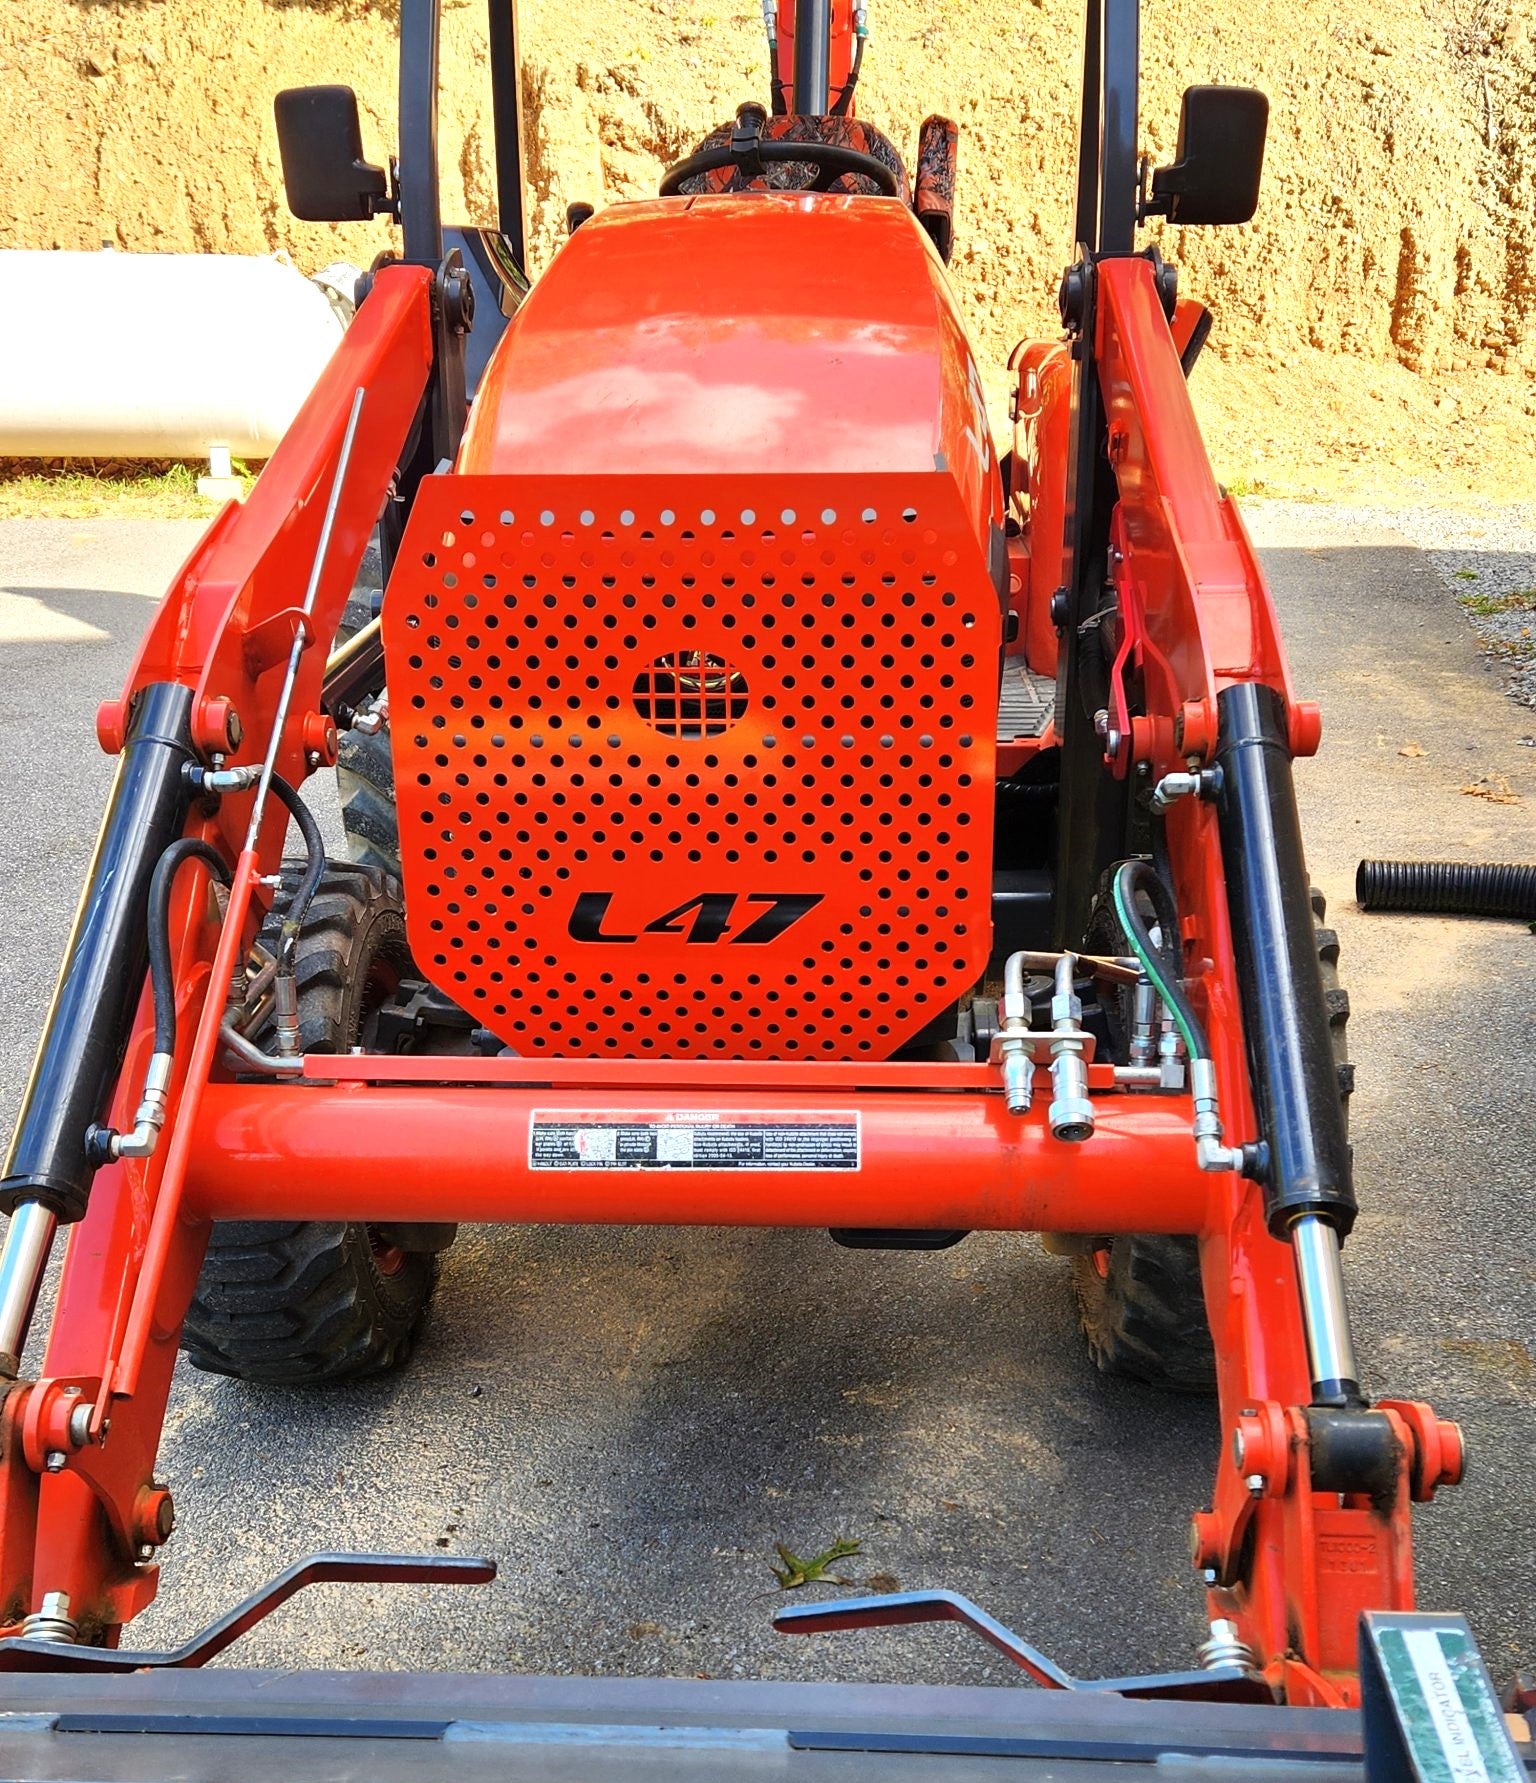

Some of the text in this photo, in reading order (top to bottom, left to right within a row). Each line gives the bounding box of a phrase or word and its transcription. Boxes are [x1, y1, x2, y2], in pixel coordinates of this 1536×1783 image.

[567, 891, 825, 945] L47
[675, 1112, 720, 1122] DANGER
[1428, 1671, 1464, 1746] INDICATOR
